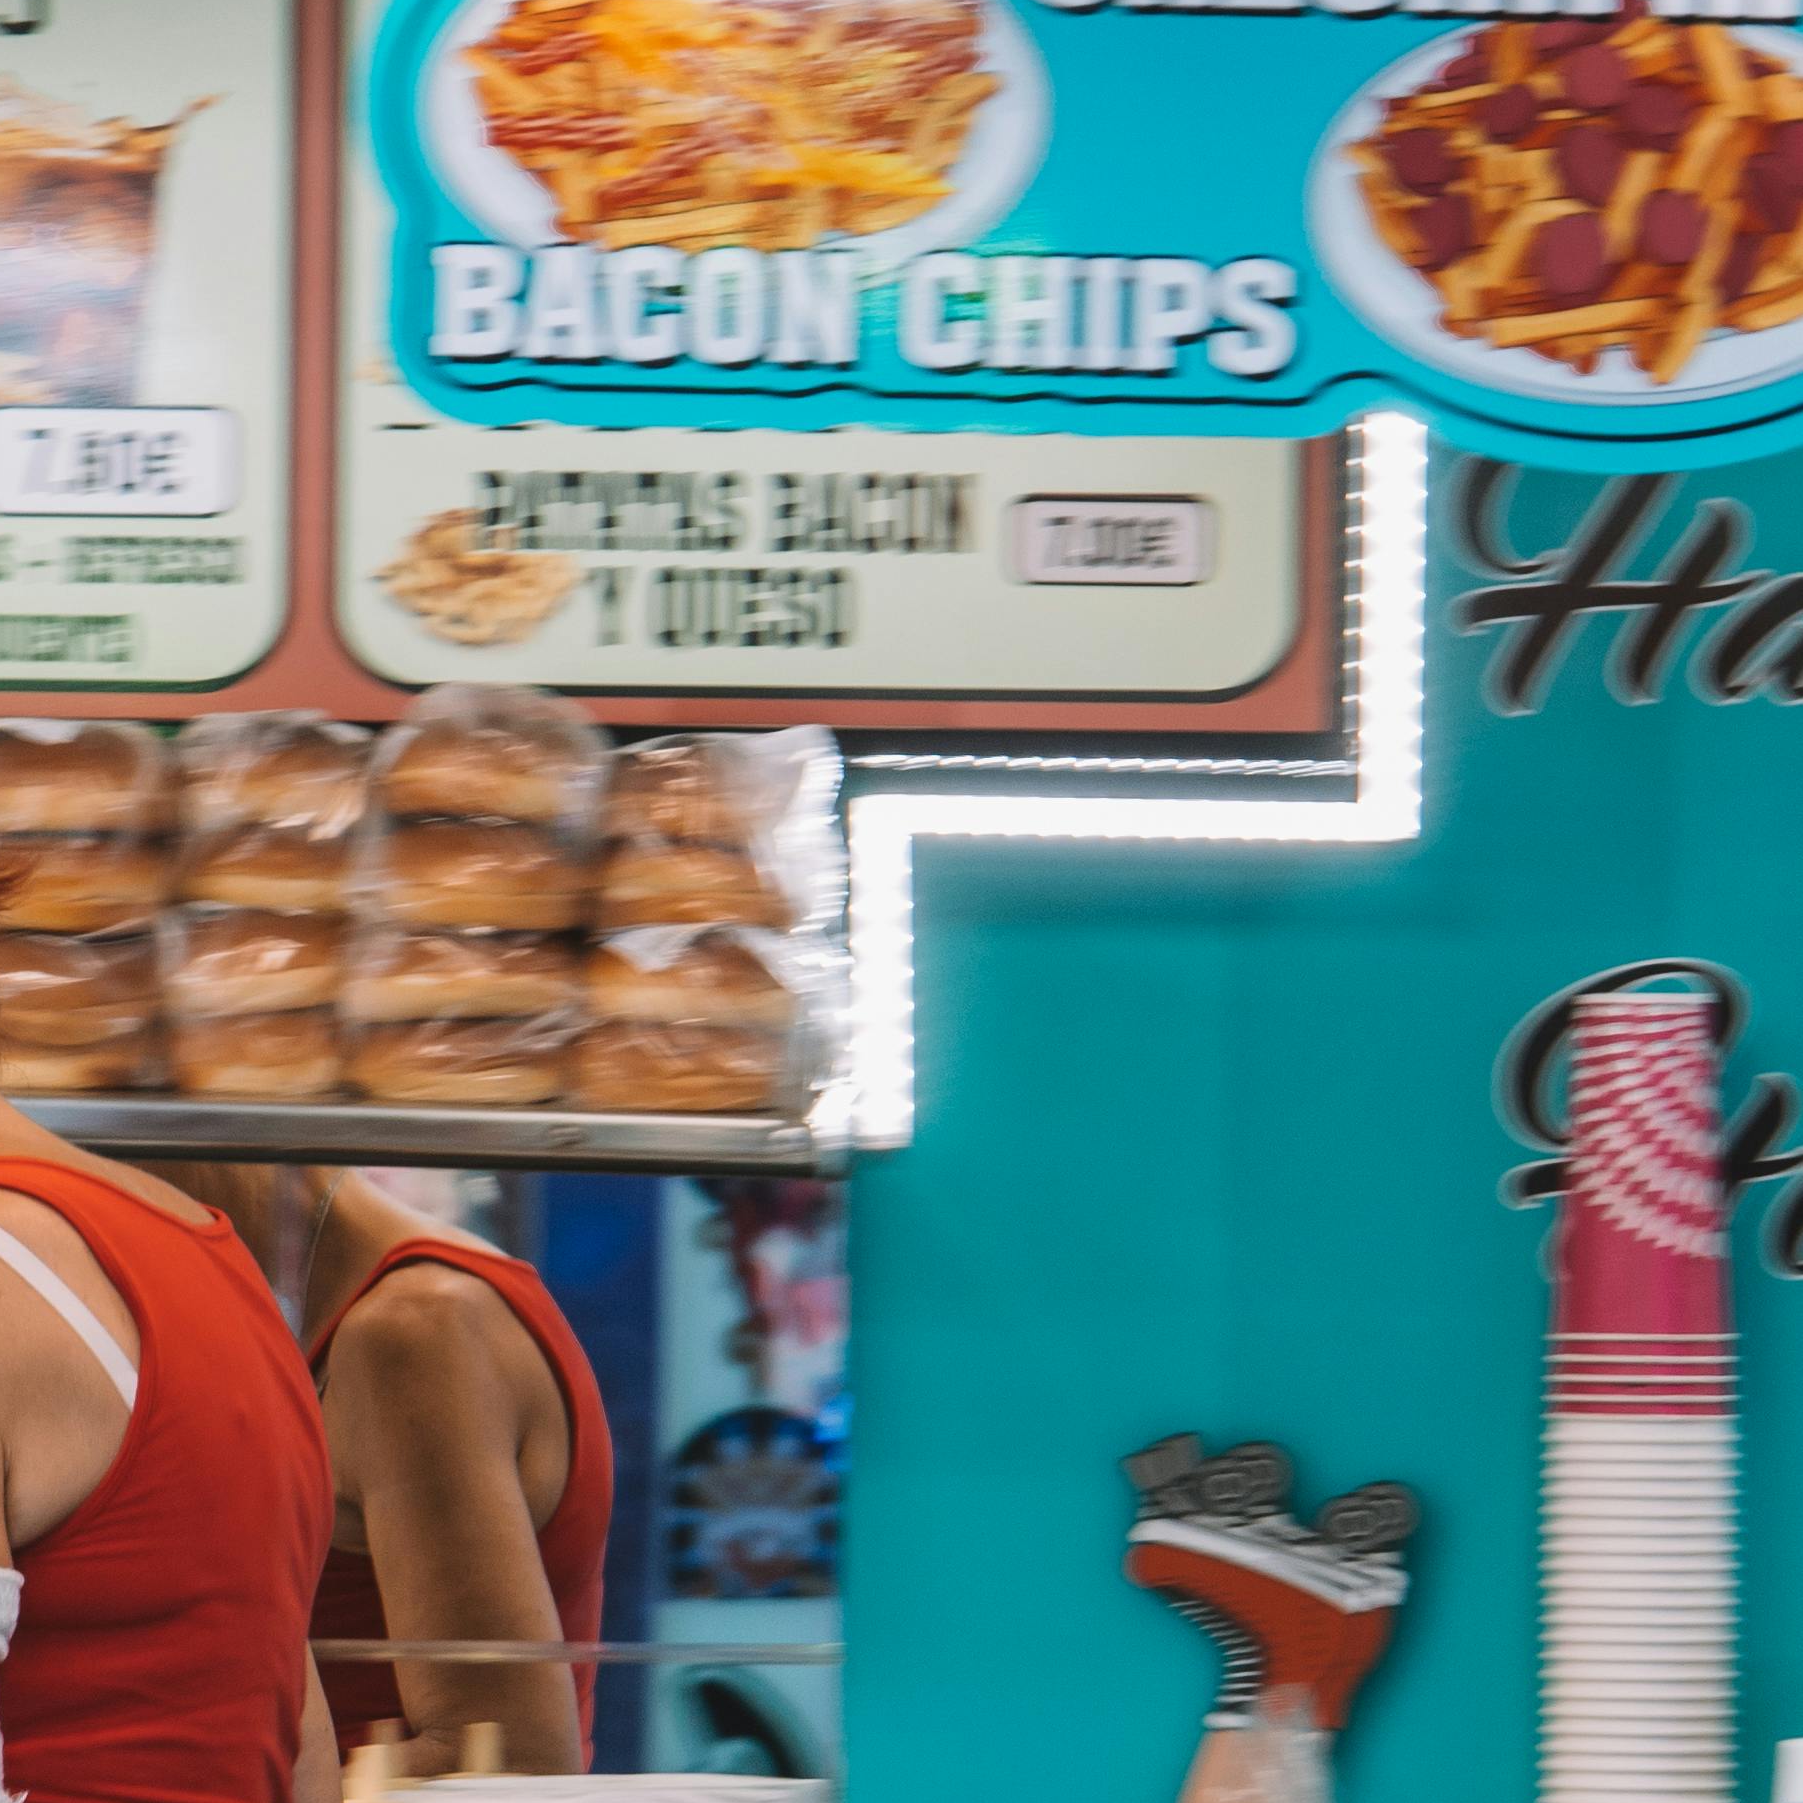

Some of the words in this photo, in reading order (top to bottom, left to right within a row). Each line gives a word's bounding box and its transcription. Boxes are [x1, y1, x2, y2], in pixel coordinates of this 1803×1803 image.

[429, 239, 864, 366] BACON
[894, 248, 1302, 378] CHIPS
[766, 471, 983, 554] BACON
[649, 565, 860, 648] QUESO
